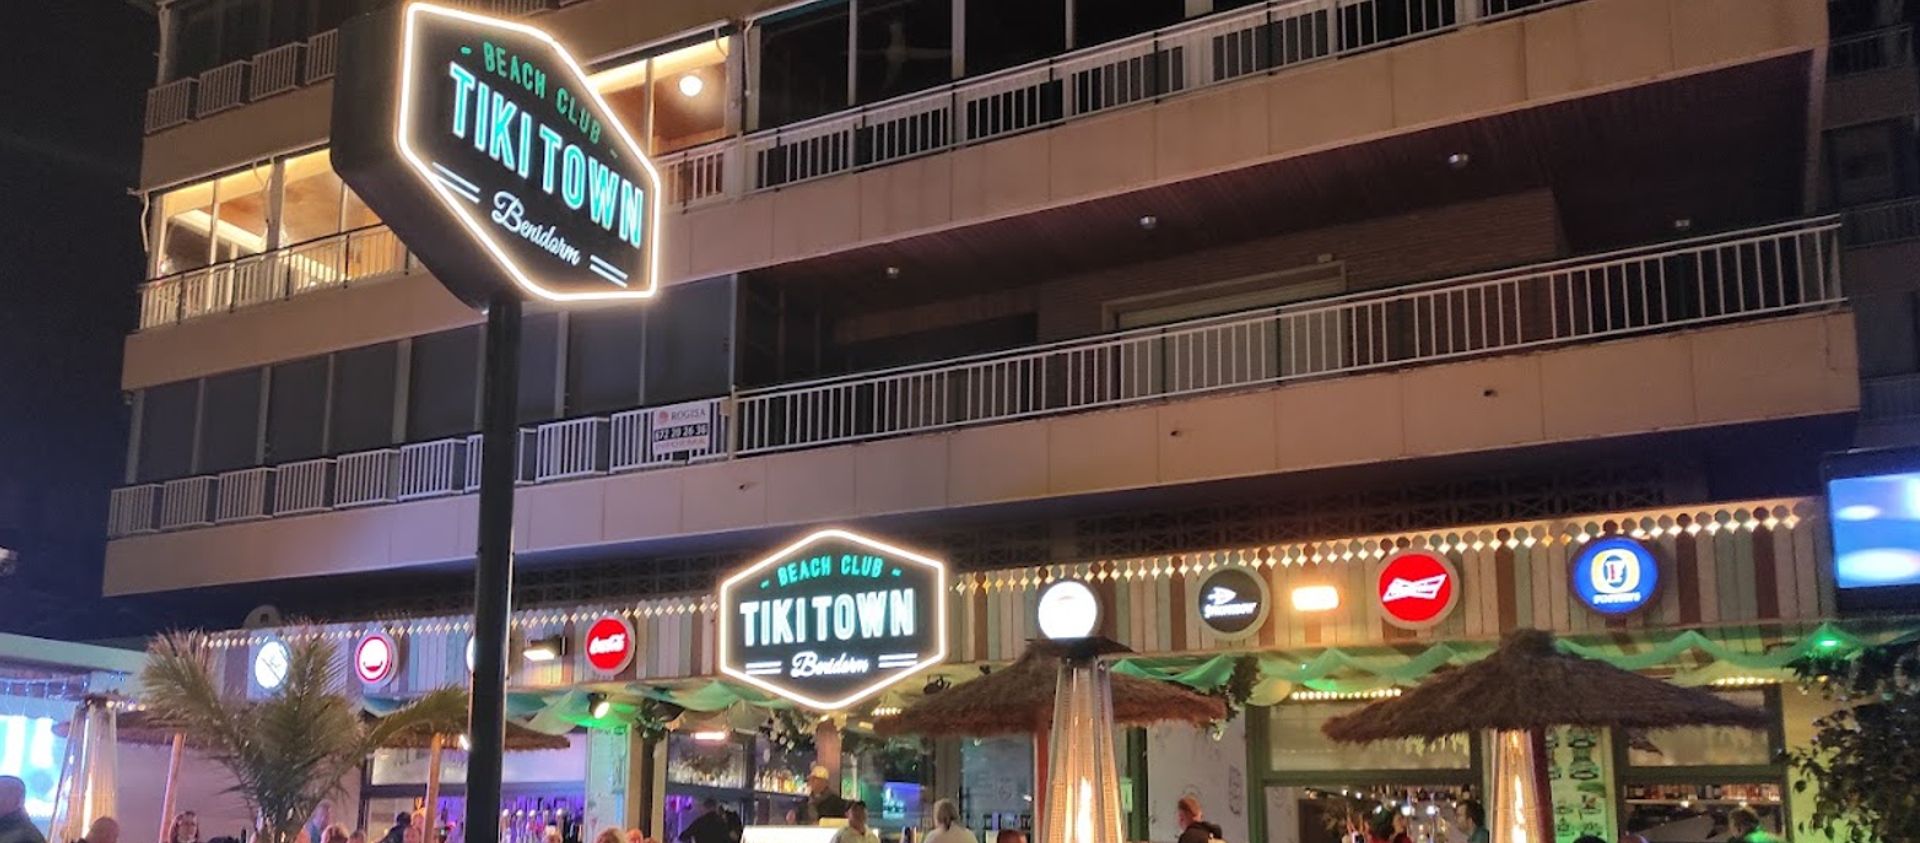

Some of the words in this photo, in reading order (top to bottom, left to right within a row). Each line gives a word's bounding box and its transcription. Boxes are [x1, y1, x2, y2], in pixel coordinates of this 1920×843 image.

[483, 41, 546, 98] BEACH
[556, 87, 601, 144] CLUB
[491, 190, 581, 266] Benidorm
[777, 555, 831, 587] BEACH
[840, 554, 884, 578] CLUB
[790, 651, 869, 678] Benidorm
